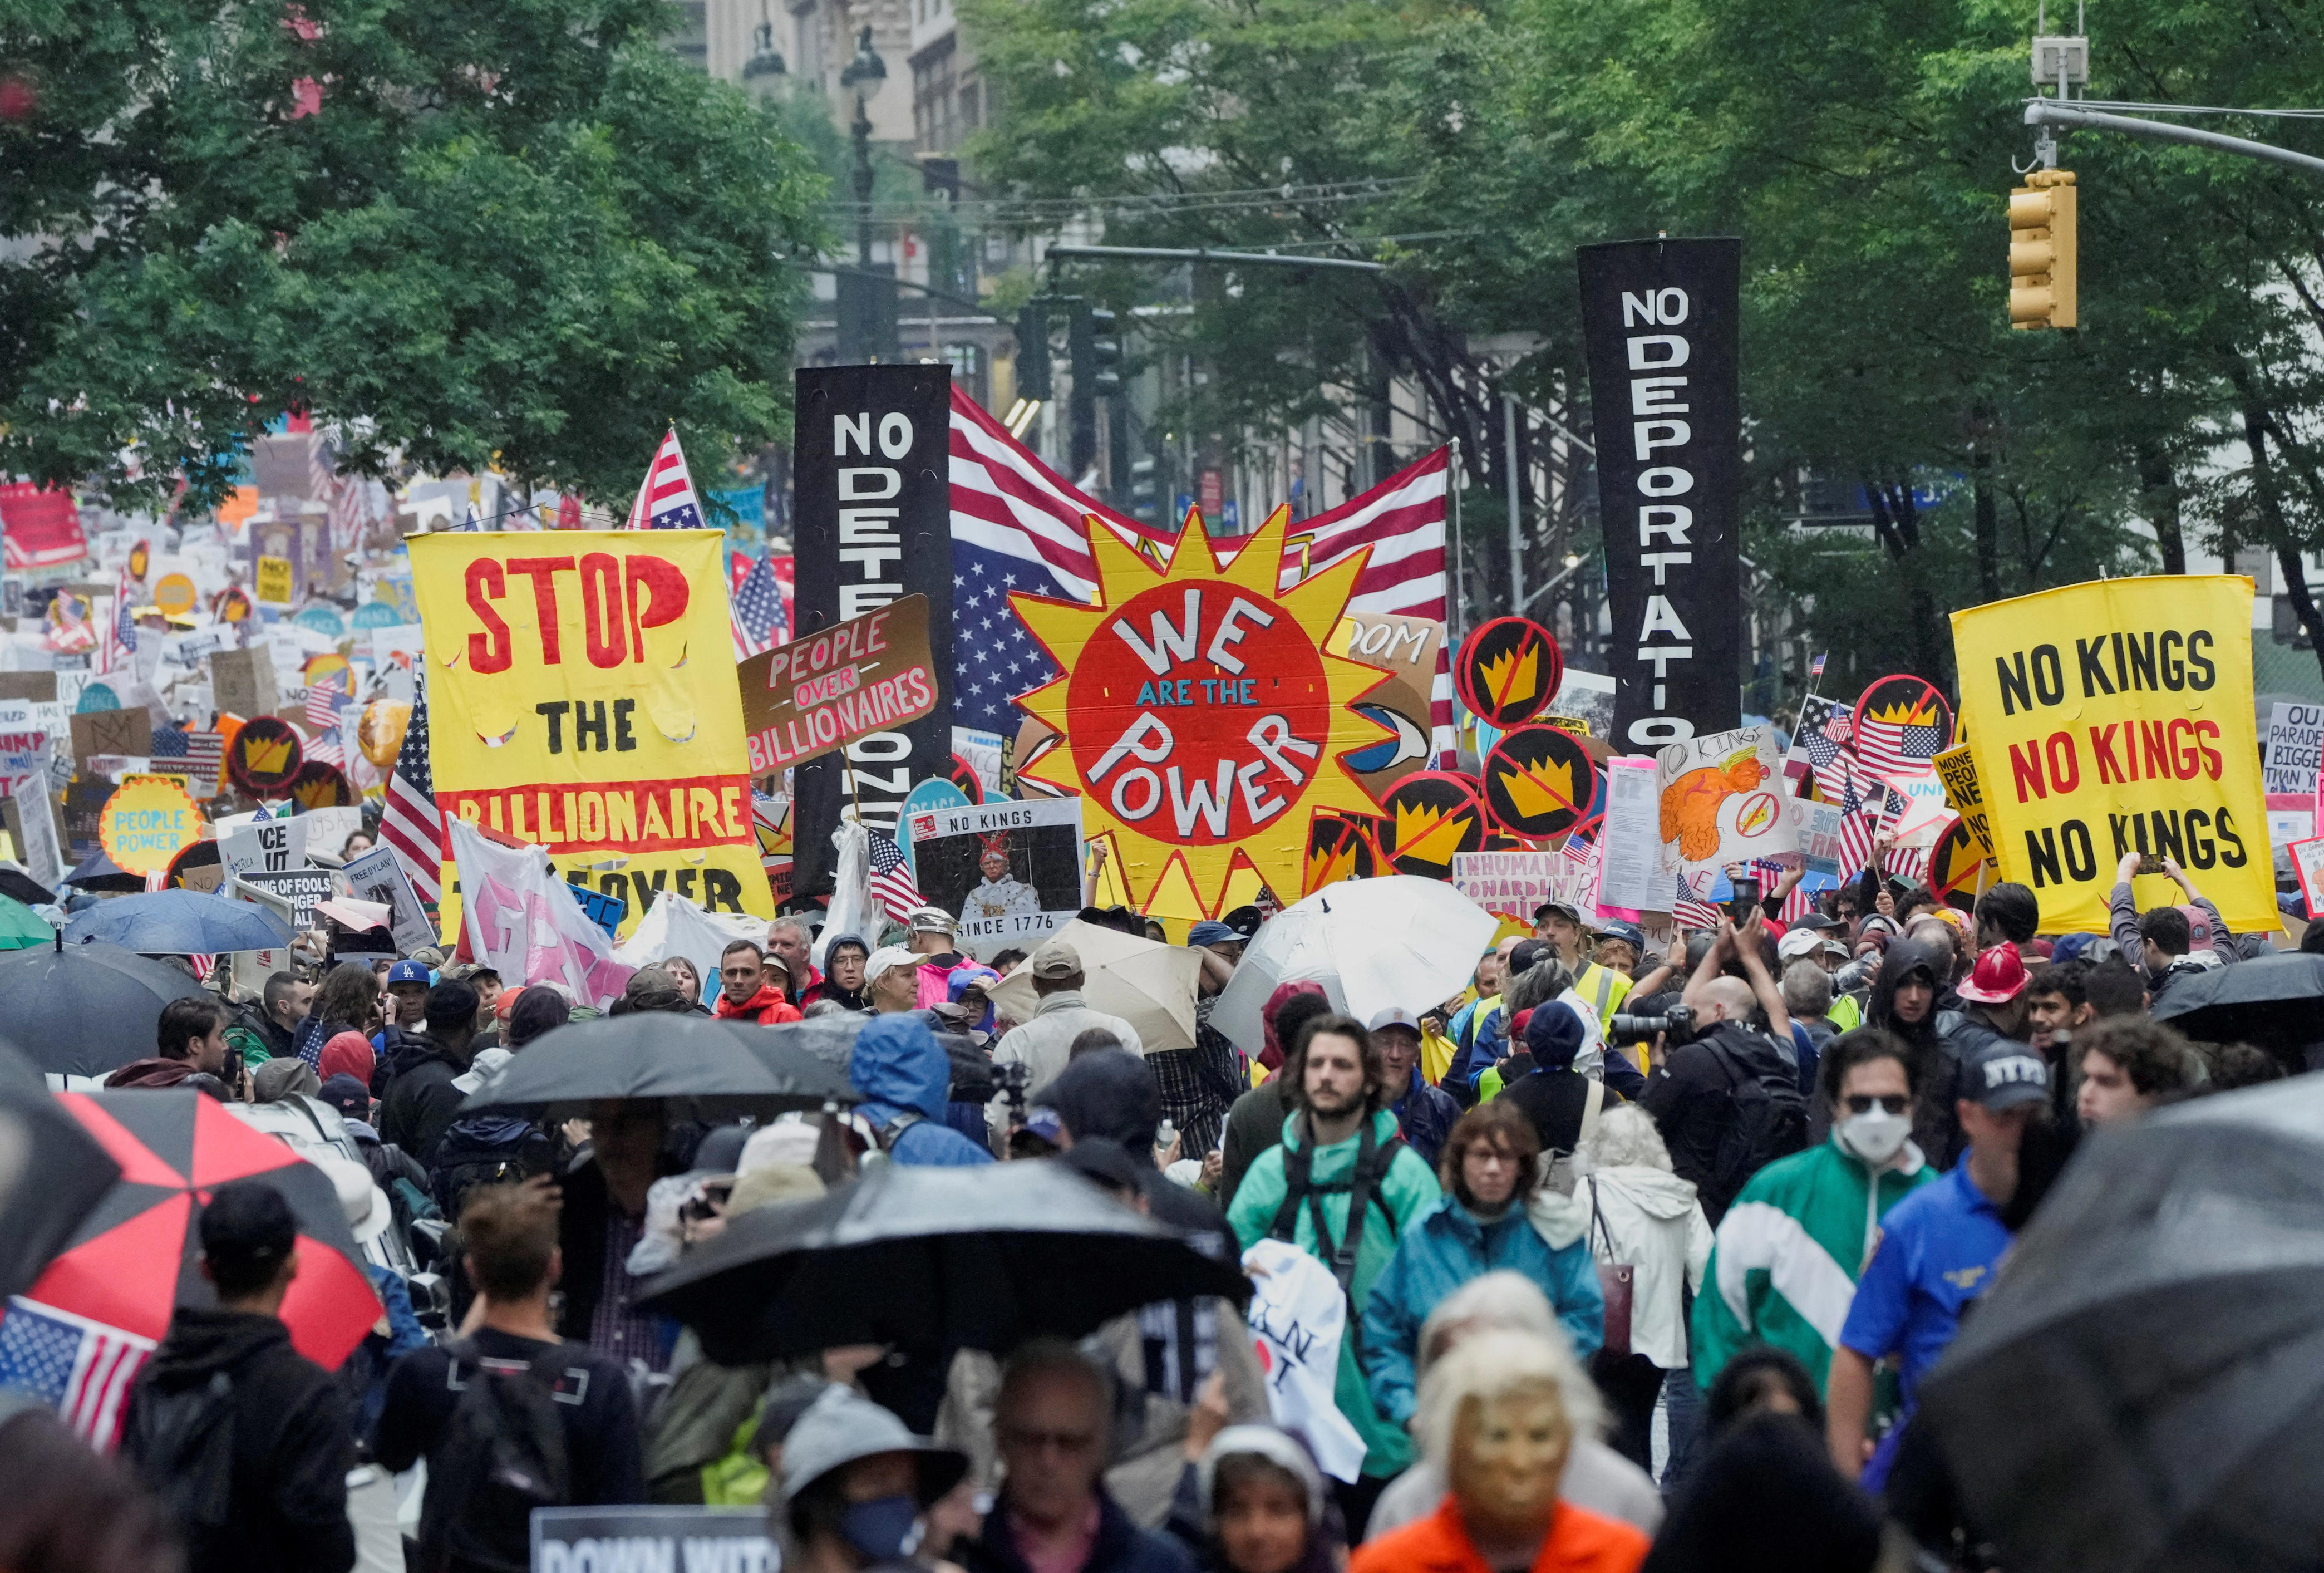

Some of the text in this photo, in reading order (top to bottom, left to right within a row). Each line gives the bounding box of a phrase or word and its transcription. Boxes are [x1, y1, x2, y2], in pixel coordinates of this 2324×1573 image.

[1622, 287, 1688, 327] NO
[834, 411, 914, 460] NO
[465, 552, 690, 674] STOP
[1112, 589, 1275, 676] WE
[769, 611, 891, 689] PEOPLE
[1996, 630, 2215, 716] NO KINGS
[285, 689, 309, 701] NO
[796, 667, 855, 707] OVER
[1136, 679, 1258, 706] ARE THE
[535, 699, 637, 754] THE
[746, 665, 933, 773] BILLIONAIRES
[2288, 706, 2324, 727] OU
[1697, 726, 1763, 761] KINGS
[1938, 750, 1973, 772] MONE
[2008, 718, 2222, 803] NO KINGS
[1086, 711, 1320, 837] POWER
[115, 810, 185, 831] PEOPLE
[949, 810, 1032, 833] NO KINGS
[116, 833, 180, 852] POWER
[2025, 807, 2247, 888] NO KINGS
[265, 849, 289, 871] UT
[349, 858, 392, 883] FREE DYLAN!
[1456, 854, 1575, 877] INHUMANE
[194, 878, 213, 890] NO
[278, 879, 294, 893] OF
[294, 877, 331, 893] FOOLS
[1456, 878, 1568, 898] COWARDLY
[282, 893, 322, 910] NGER
[956, 915, 1053, 937] SINCE 1776
[403, 964, 414, 978] LA
